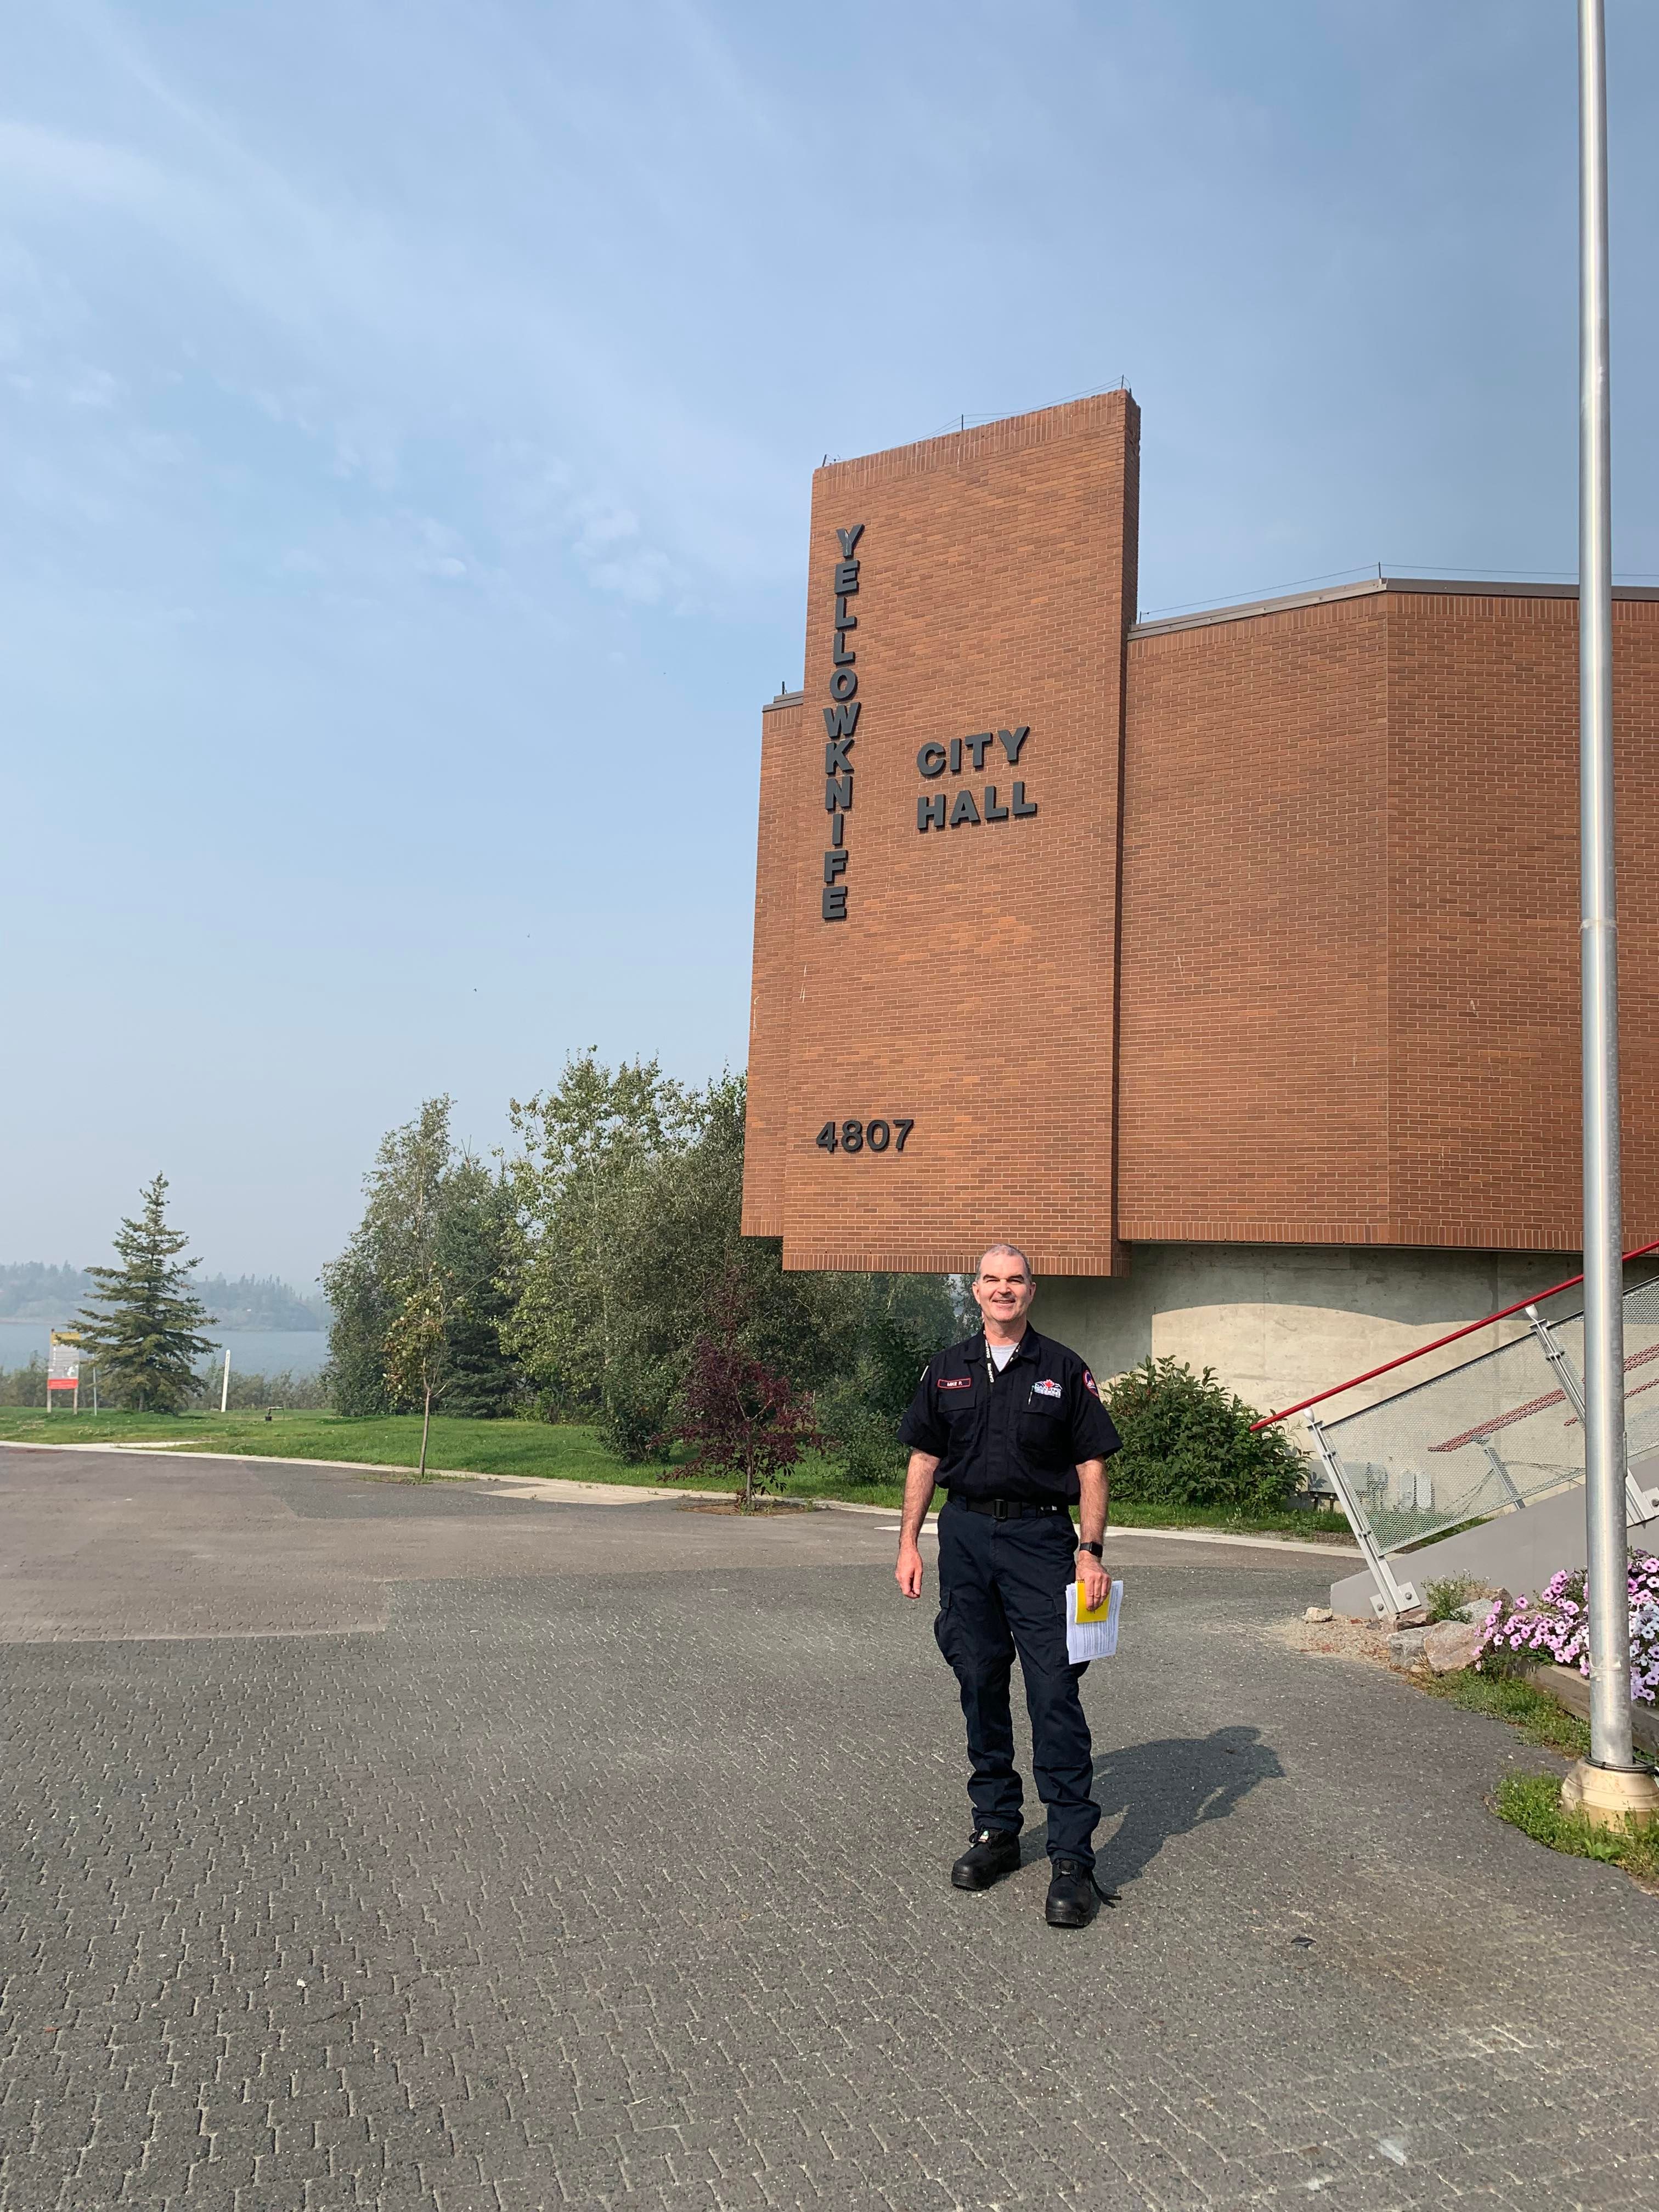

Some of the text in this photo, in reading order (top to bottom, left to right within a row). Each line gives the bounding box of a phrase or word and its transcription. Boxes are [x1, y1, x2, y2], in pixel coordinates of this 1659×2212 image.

[822, 524, 865, 919] YELLOWKNIFE
[916, 726, 1030, 777] CITY
[917, 781, 1037, 830] HALL
[816, 1119, 914, 1152] 4807
